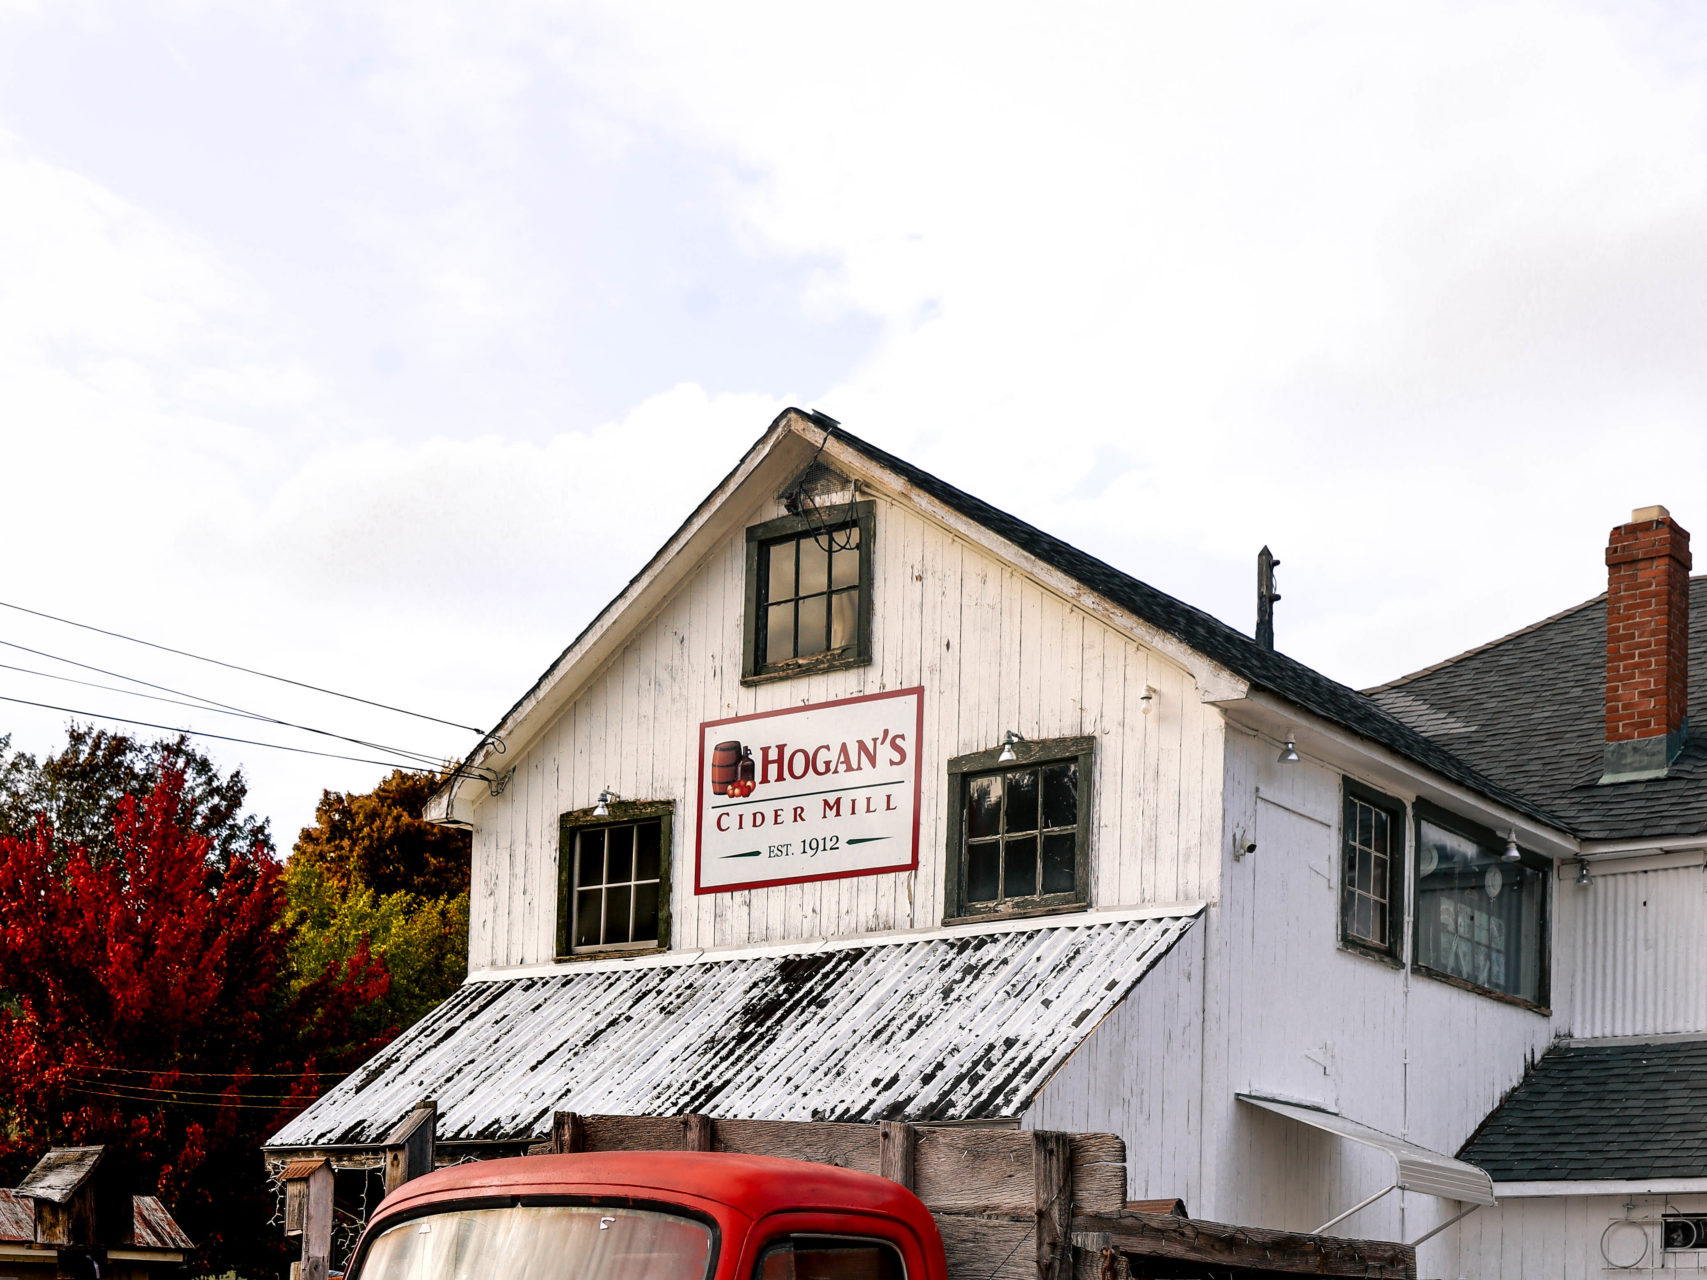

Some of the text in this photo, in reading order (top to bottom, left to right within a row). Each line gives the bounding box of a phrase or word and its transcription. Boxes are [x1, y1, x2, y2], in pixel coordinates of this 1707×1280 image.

[758, 729, 907, 784] HOGAN'S
[716, 794, 897, 832] CIDER MILL
[767, 835, 840, 858] EST. 1912
